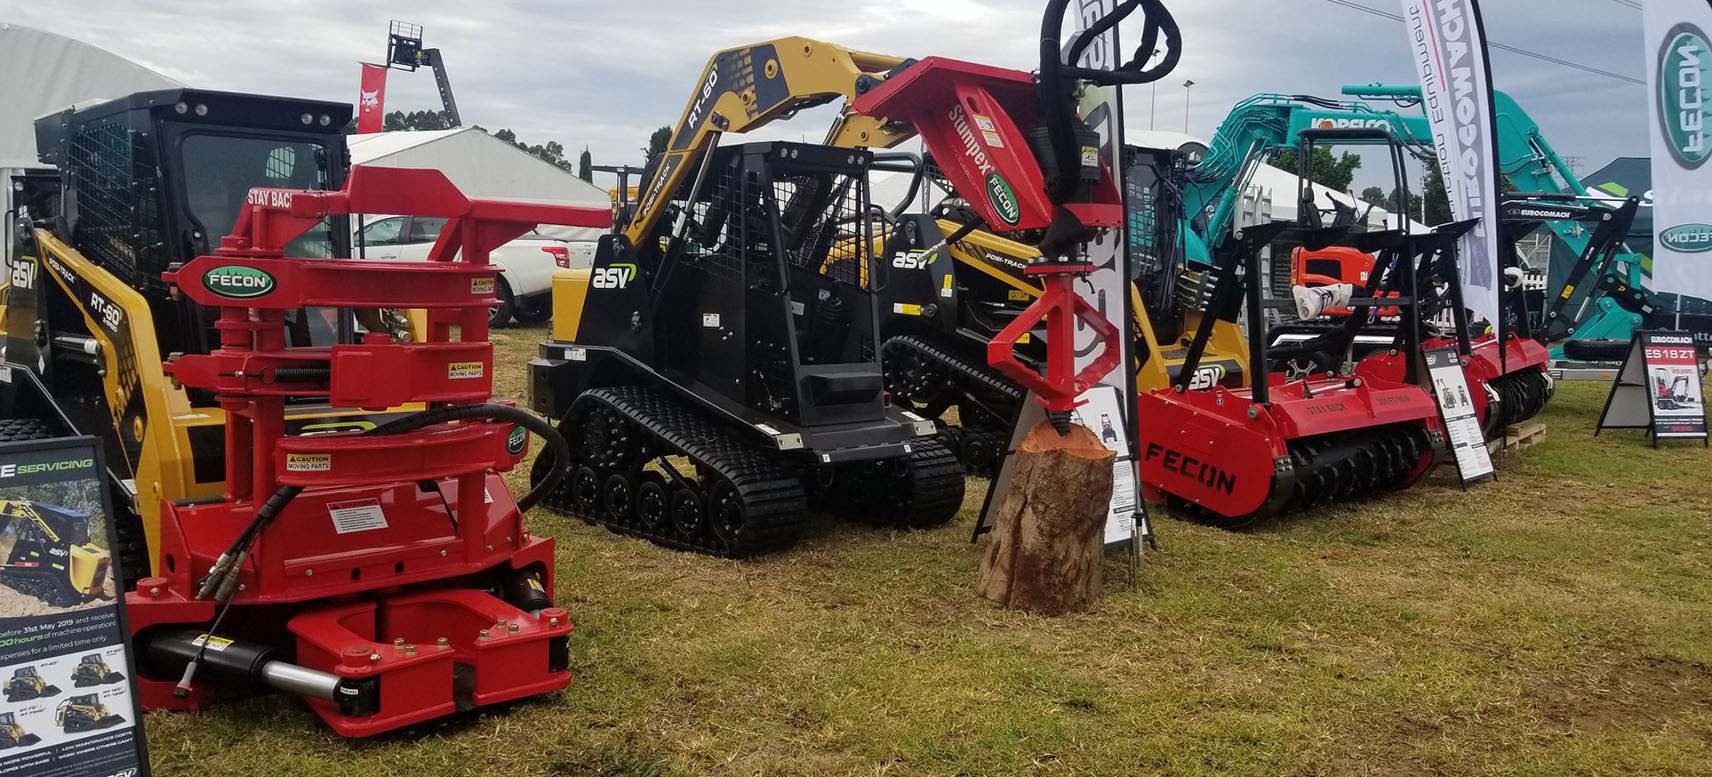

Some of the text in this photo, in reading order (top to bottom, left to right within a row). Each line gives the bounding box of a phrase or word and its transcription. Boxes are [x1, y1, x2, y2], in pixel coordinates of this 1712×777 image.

[688, 69, 718, 130] RT-60
[248, 190, 268, 206] STAY
[988, 177, 1017, 219] FECON
[1521, 209, 1571, 219] EUROCOMACH
[12, 260, 35, 290] asv
[209, 274, 267, 288] FECON
[592, 267, 630, 289] asv
[90, 292, 120, 326] RT-60
[1645, 349, 1695, 359] ES18ZT
[17, 459, 93, 474] SERVICING
[1146, 442, 1237, 496] FECON
[23, 626, 38, 634] 31st
[40, 622, 55, 632] May
[57, 619, 74, 627] 2019
[90, 612, 115, 621] receive
[14, 634, 44, 644] hours
[52, 628, 81, 637] machine
[0, 650, 31, 661] xpenses
[31, 647, 41, 655] for
[48, 641, 74, 652] limited
[74, 637, 90, 647] time
